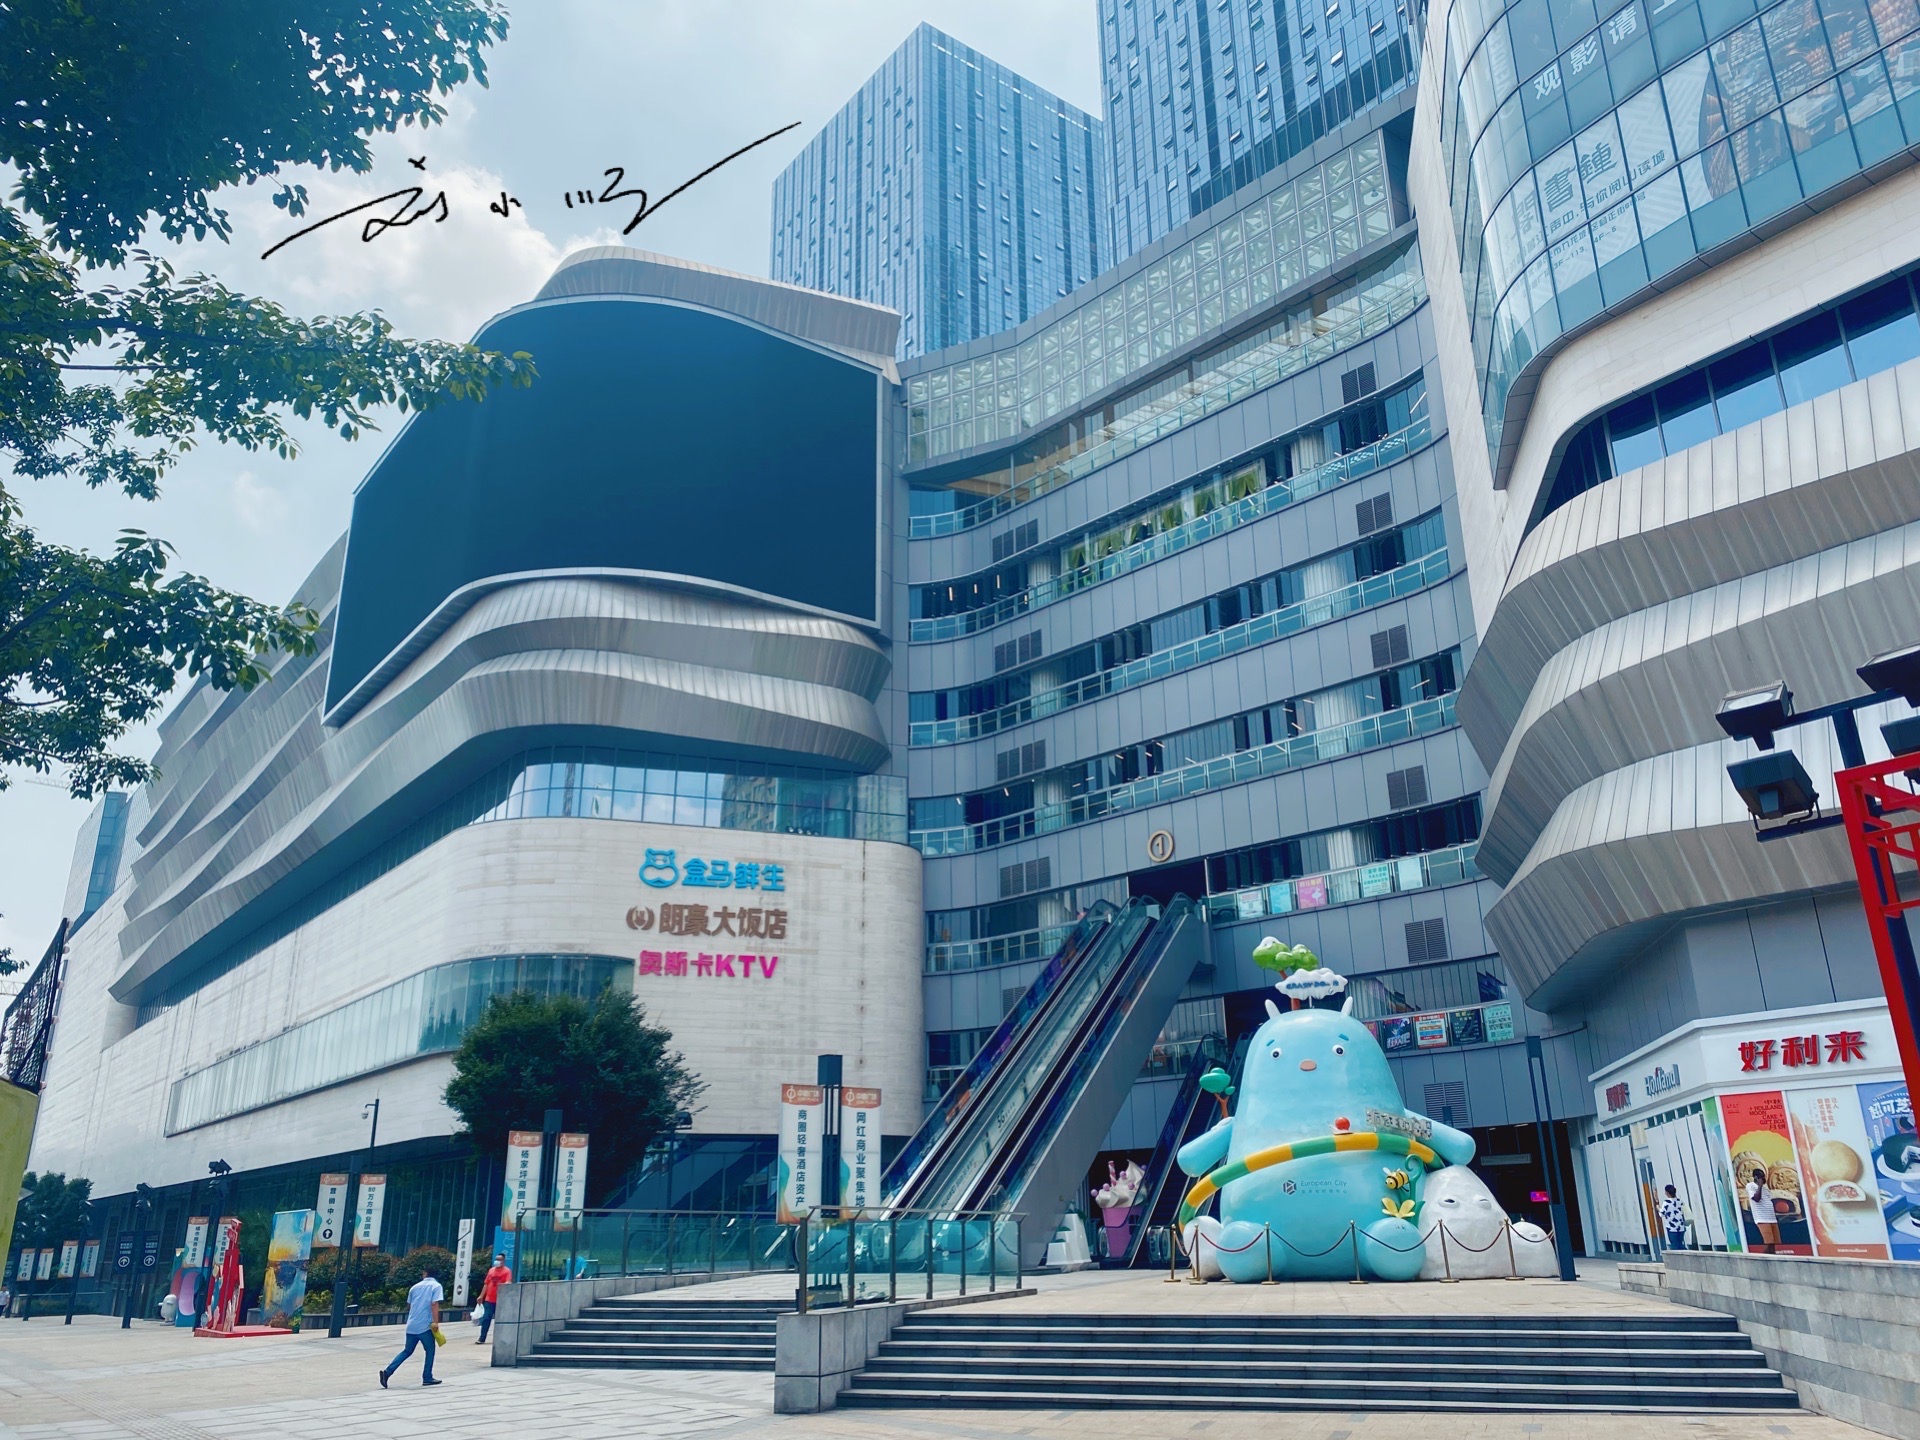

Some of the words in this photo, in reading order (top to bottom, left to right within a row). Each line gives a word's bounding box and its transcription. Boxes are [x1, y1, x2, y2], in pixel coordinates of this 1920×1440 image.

[681, 858, 785, 891] 盒马鲜生
[659, 902, 788, 939] 朗豪大饭店
[639, 950, 779, 978] 奥斯卡KTV
[1738, 1031, 1868, 1072] 好利来
[855, 1112, 866, 1207] 网红商业聚集地
